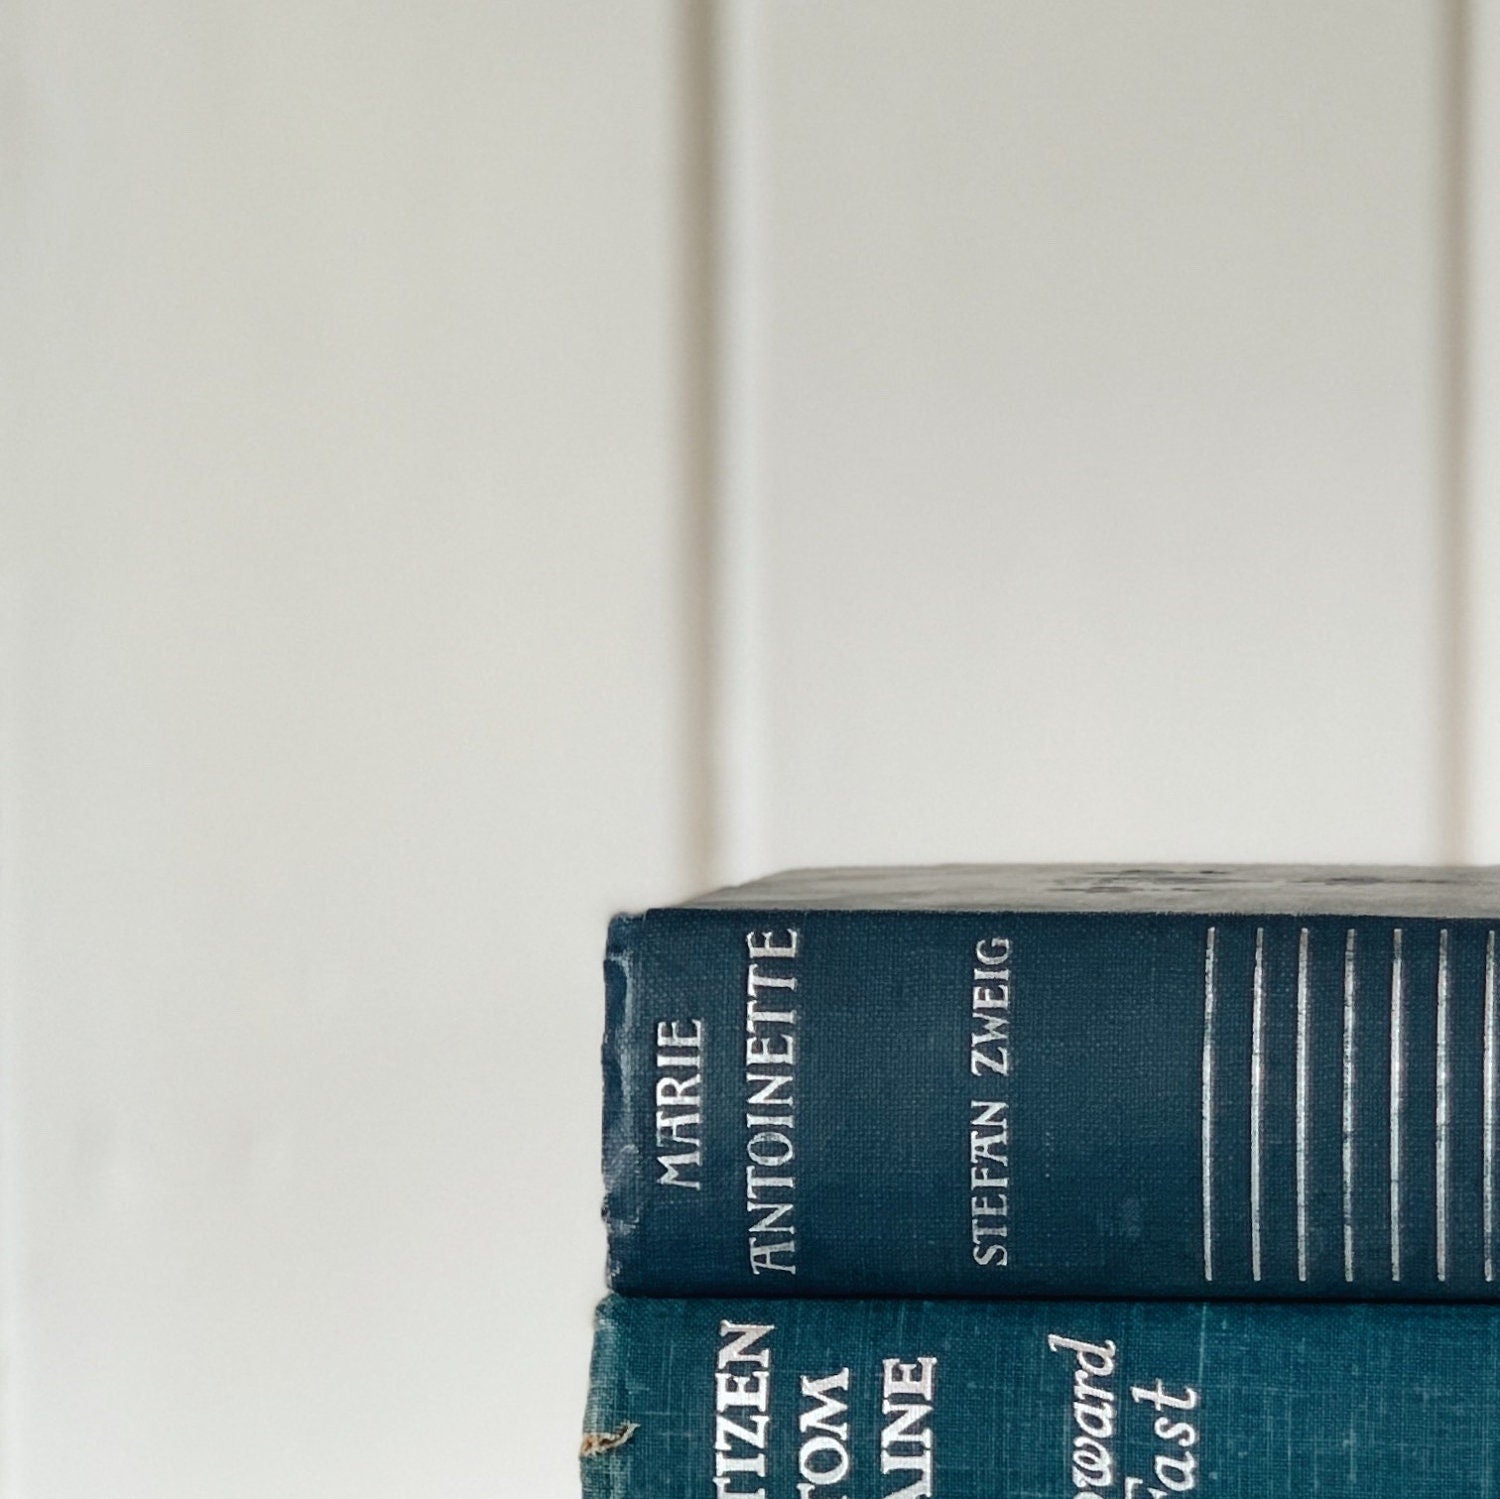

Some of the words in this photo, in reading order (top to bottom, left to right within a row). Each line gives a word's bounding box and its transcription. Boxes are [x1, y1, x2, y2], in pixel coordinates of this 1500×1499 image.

[971, 937, 1012, 1076] ZWEIG
[656, 1018, 702, 1190] MARIE
[746, 928, 798, 1275] ANTOINETTE
[971, 1100, 1008, 1267] STEFAN
